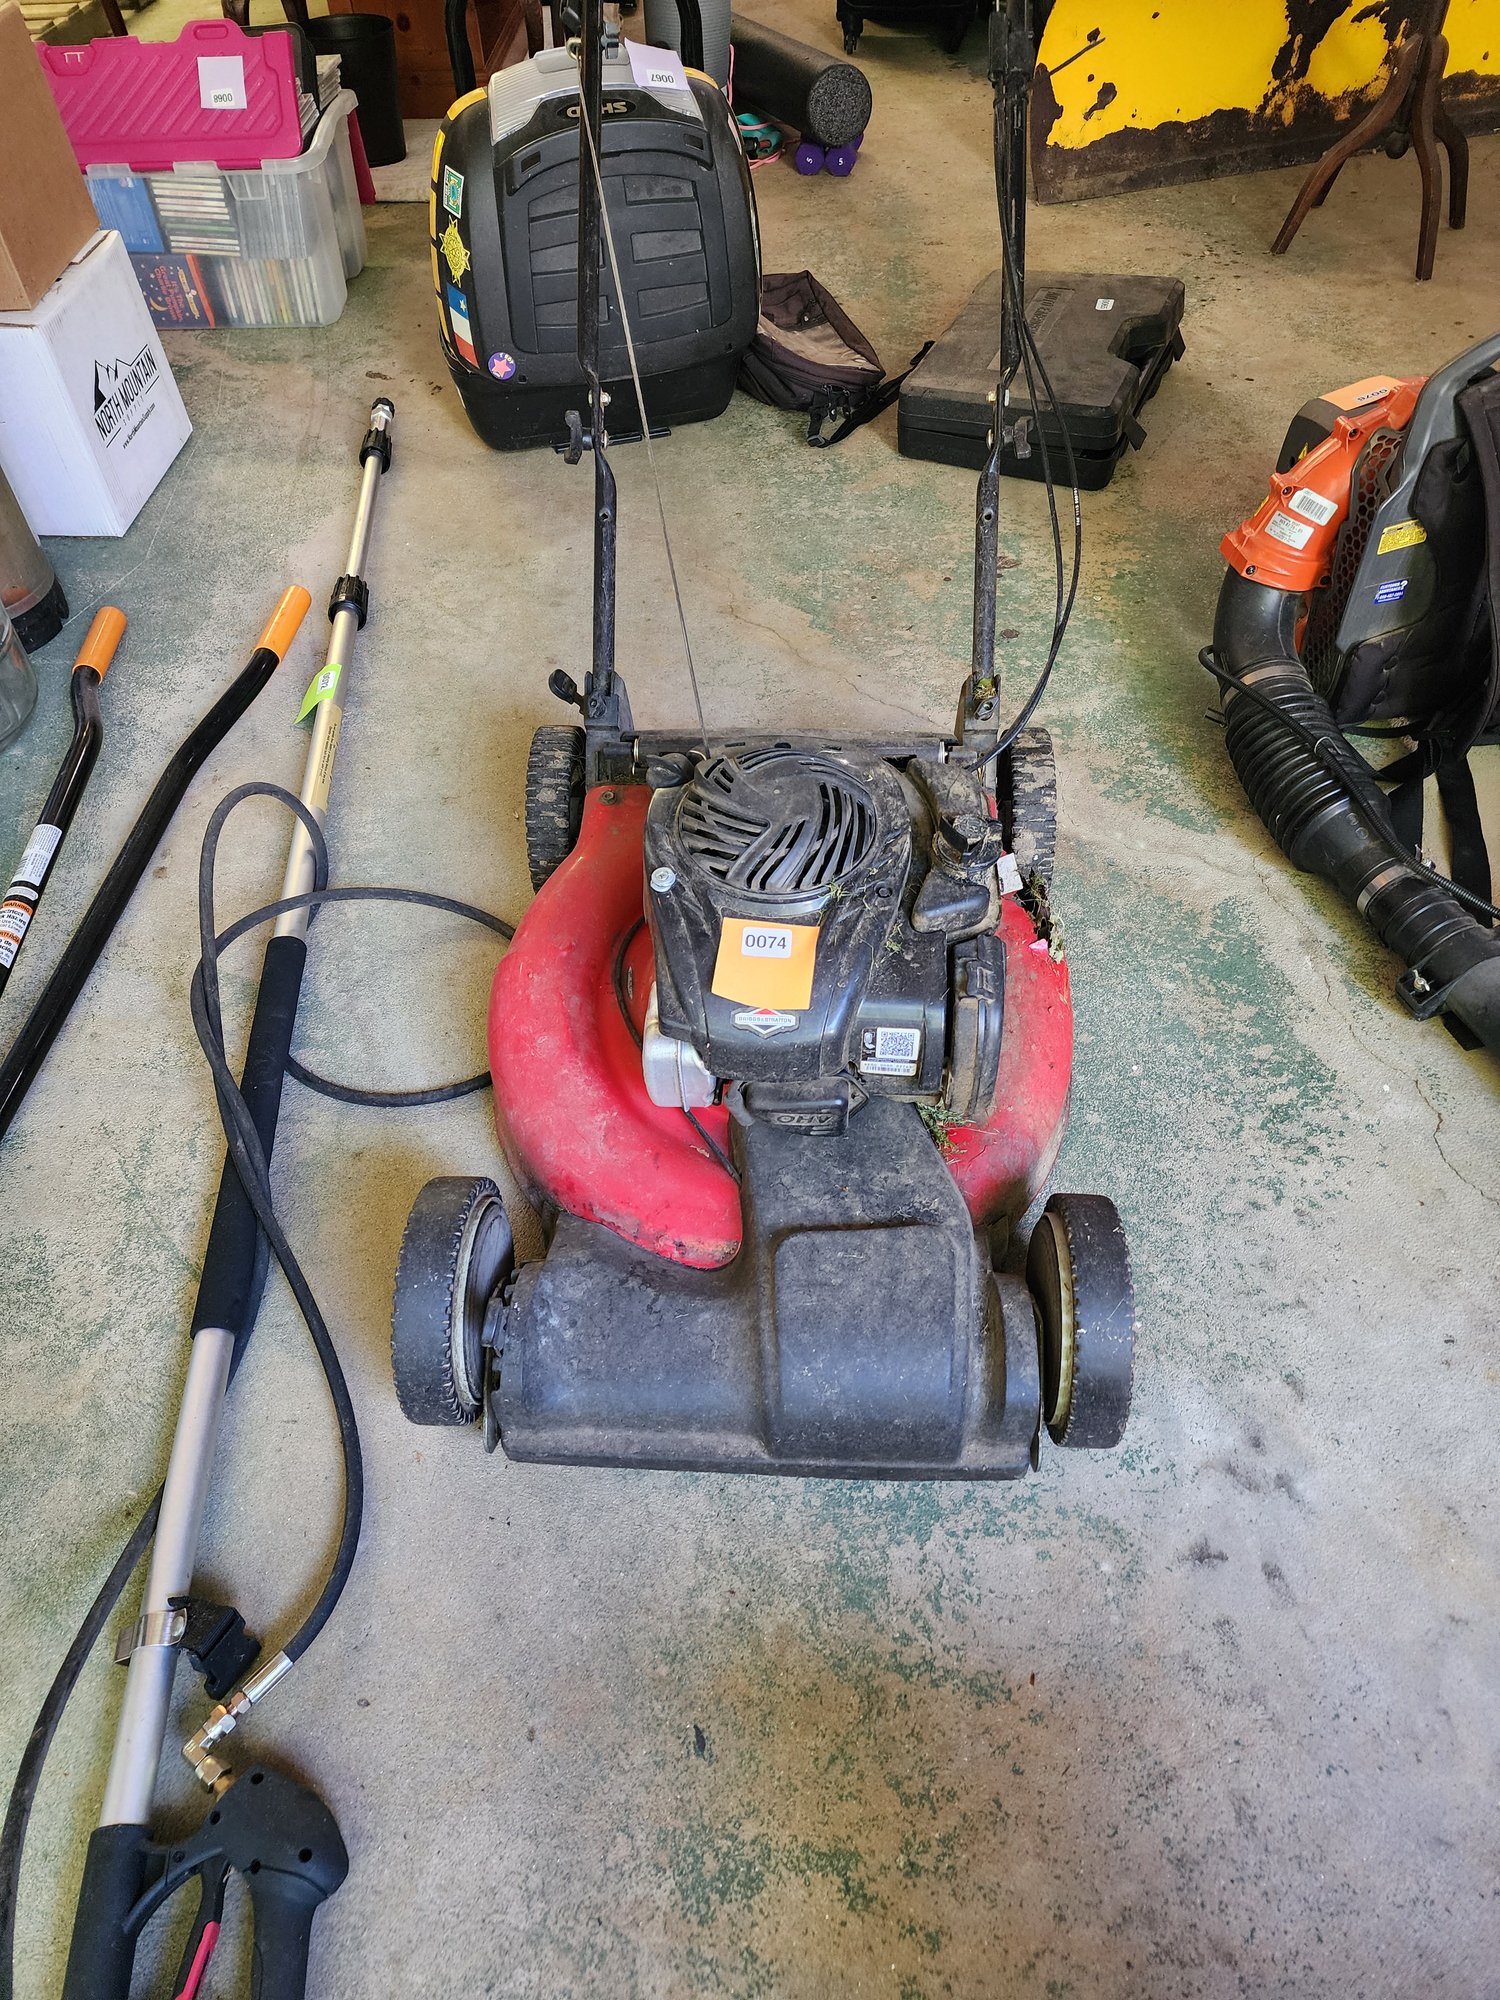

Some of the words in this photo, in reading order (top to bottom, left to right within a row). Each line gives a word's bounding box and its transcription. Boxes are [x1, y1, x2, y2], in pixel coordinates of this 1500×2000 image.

[650, 73, 675, 84] 0067
[213, 92, 233, 104] 0068
[566, 101, 628, 118] SHD
[838, 157, 844, 166] 5
[94, 392, 124, 441] NORTH
[117, 347, 158, 411] MOUNTAIN
[745, 934, 787, 950] 0074
